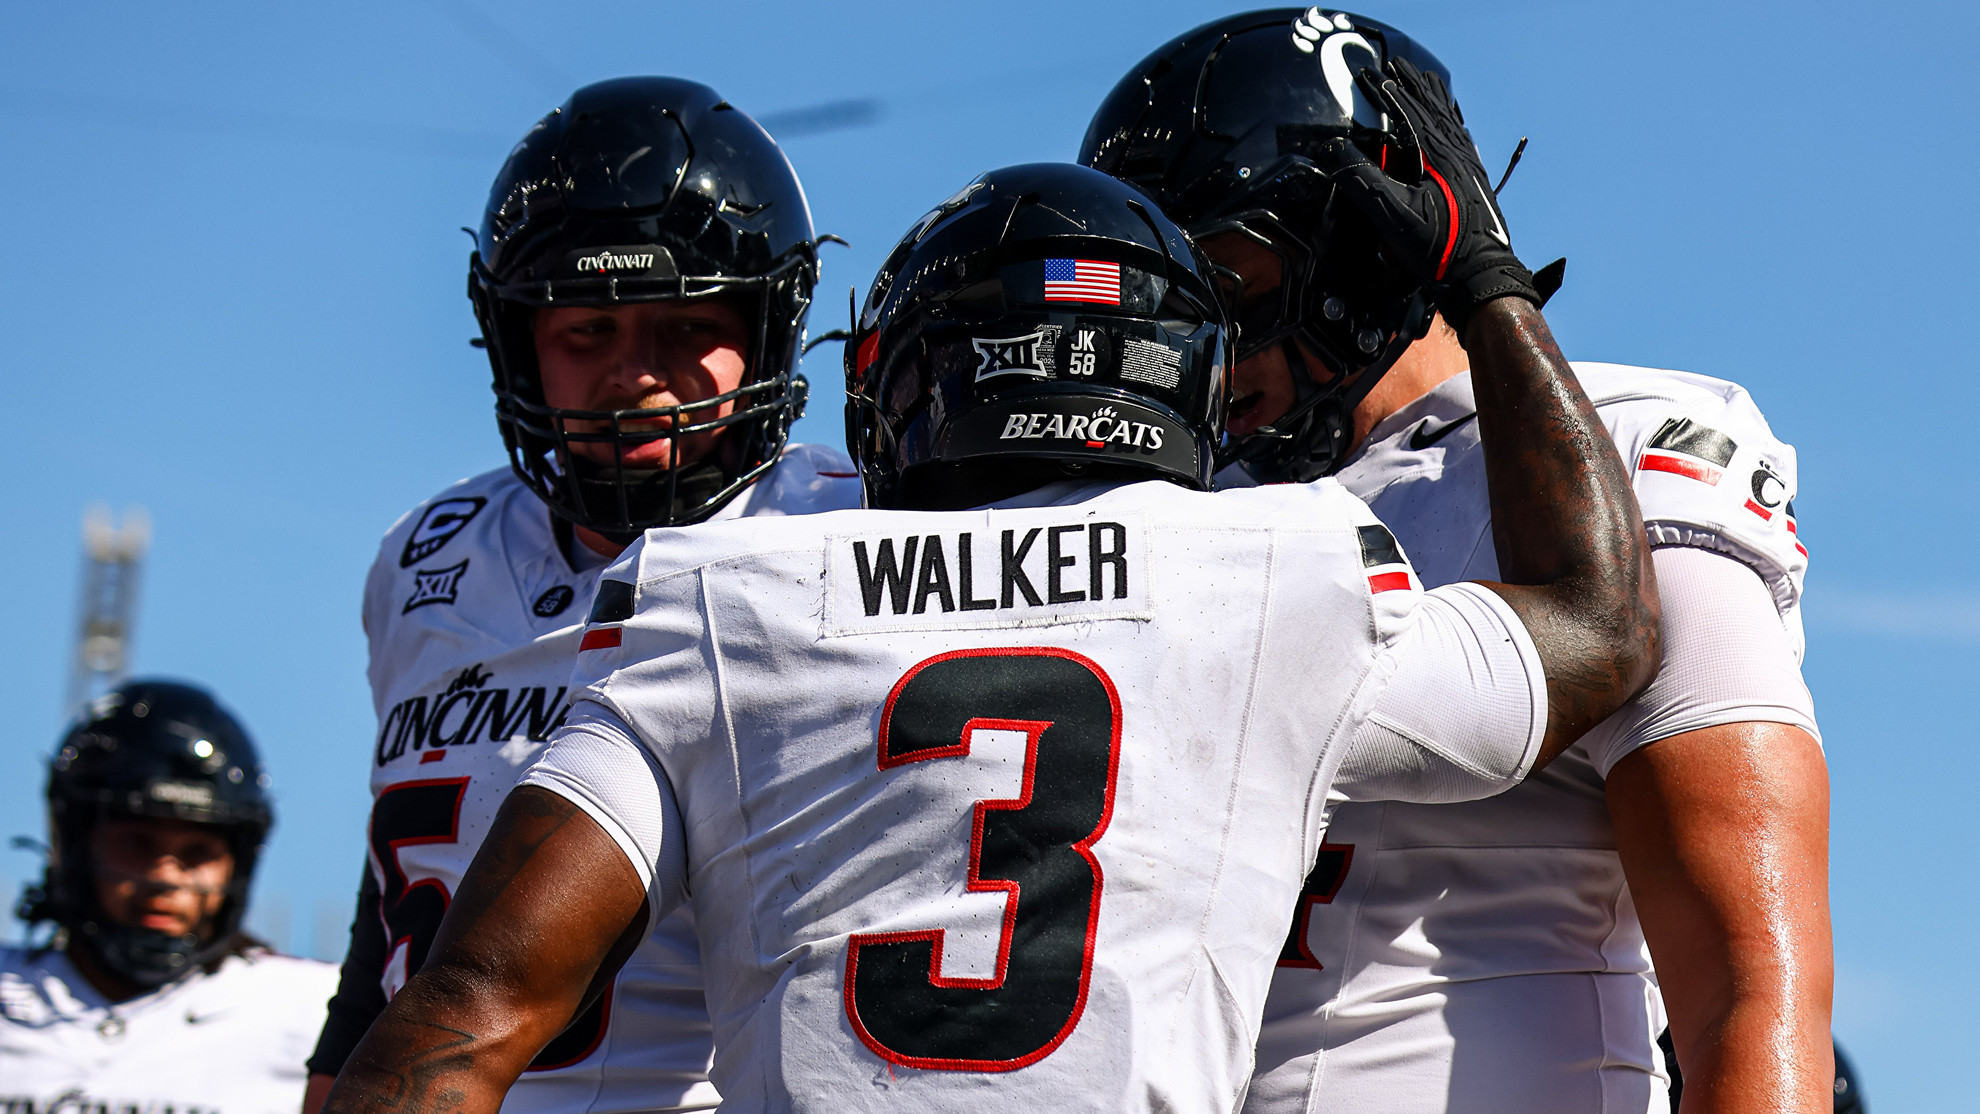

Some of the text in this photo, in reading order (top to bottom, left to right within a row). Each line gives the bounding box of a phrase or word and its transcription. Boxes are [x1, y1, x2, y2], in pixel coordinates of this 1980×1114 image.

[577, 252, 654, 272] CINCINNATI
[1071, 330, 1095, 352] JK
[1069, 353, 1095, 376] 58
[1000, 408, 1164, 449] BEARCATS
[853, 521, 1128, 616] WALKER
[537, 599, 559, 613] 58
[844, 646, 1123, 1072] 3
